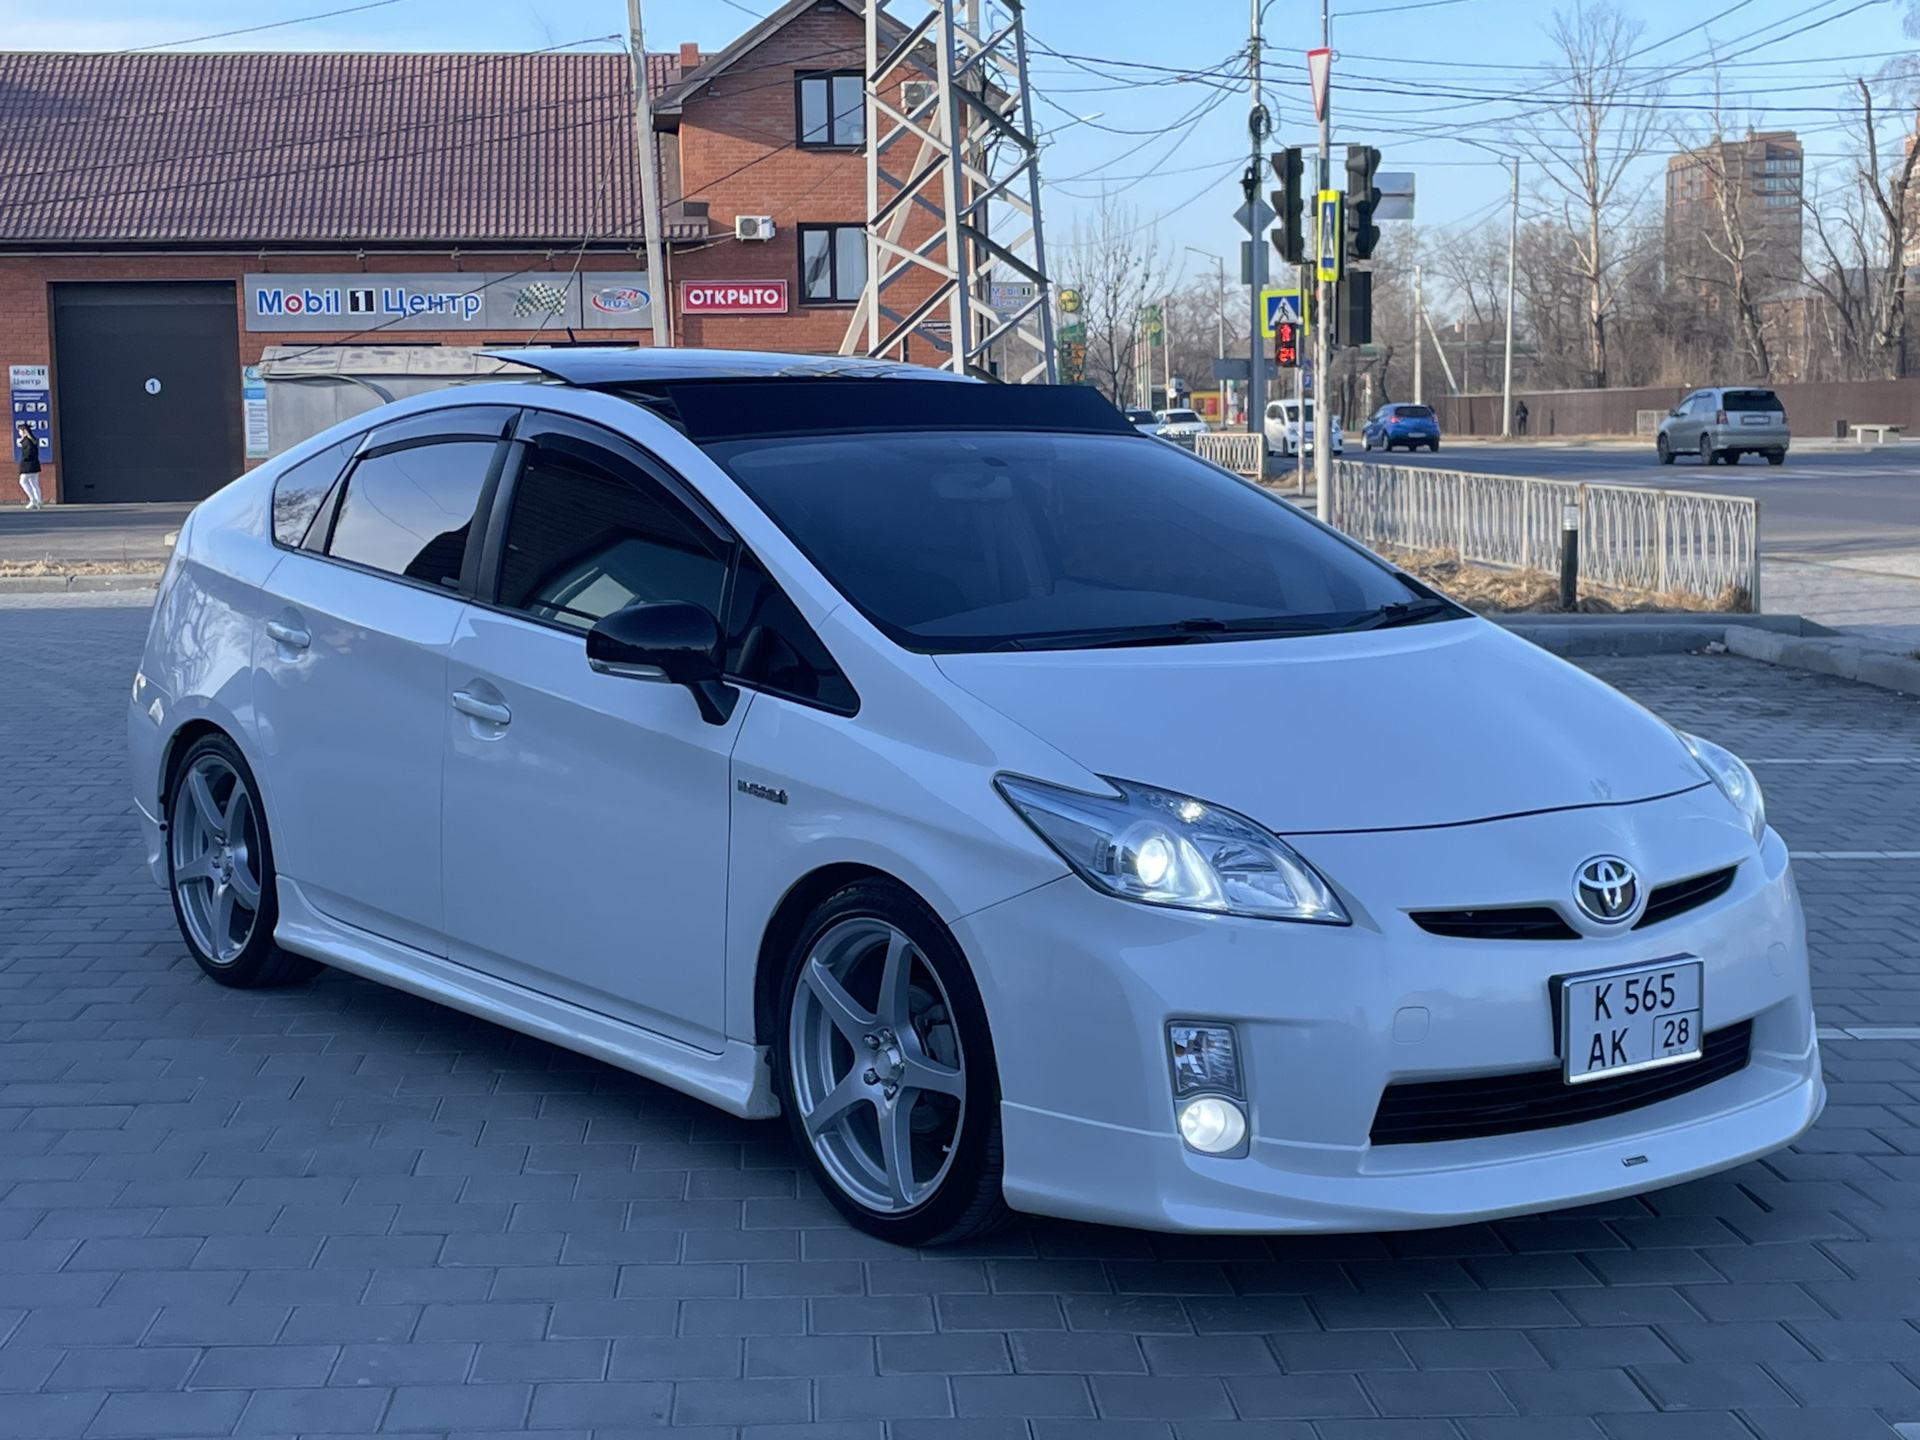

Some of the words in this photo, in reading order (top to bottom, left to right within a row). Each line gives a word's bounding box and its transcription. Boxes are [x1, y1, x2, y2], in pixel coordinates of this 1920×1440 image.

[257, 288, 341, 315] Mobil
[350, 290, 375, 313] 1
[383, 288, 482, 320] Центр
[689, 289, 779, 305] ОТКРЫТО
[149, 381, 156, 392] 1
[1595, 983, 1613, 1021] К
[1624, 973, 1675, 1015] 565
[1663, 1017, 1689, 1048] 28
[1587, 1027, 1629, 1070] АК
